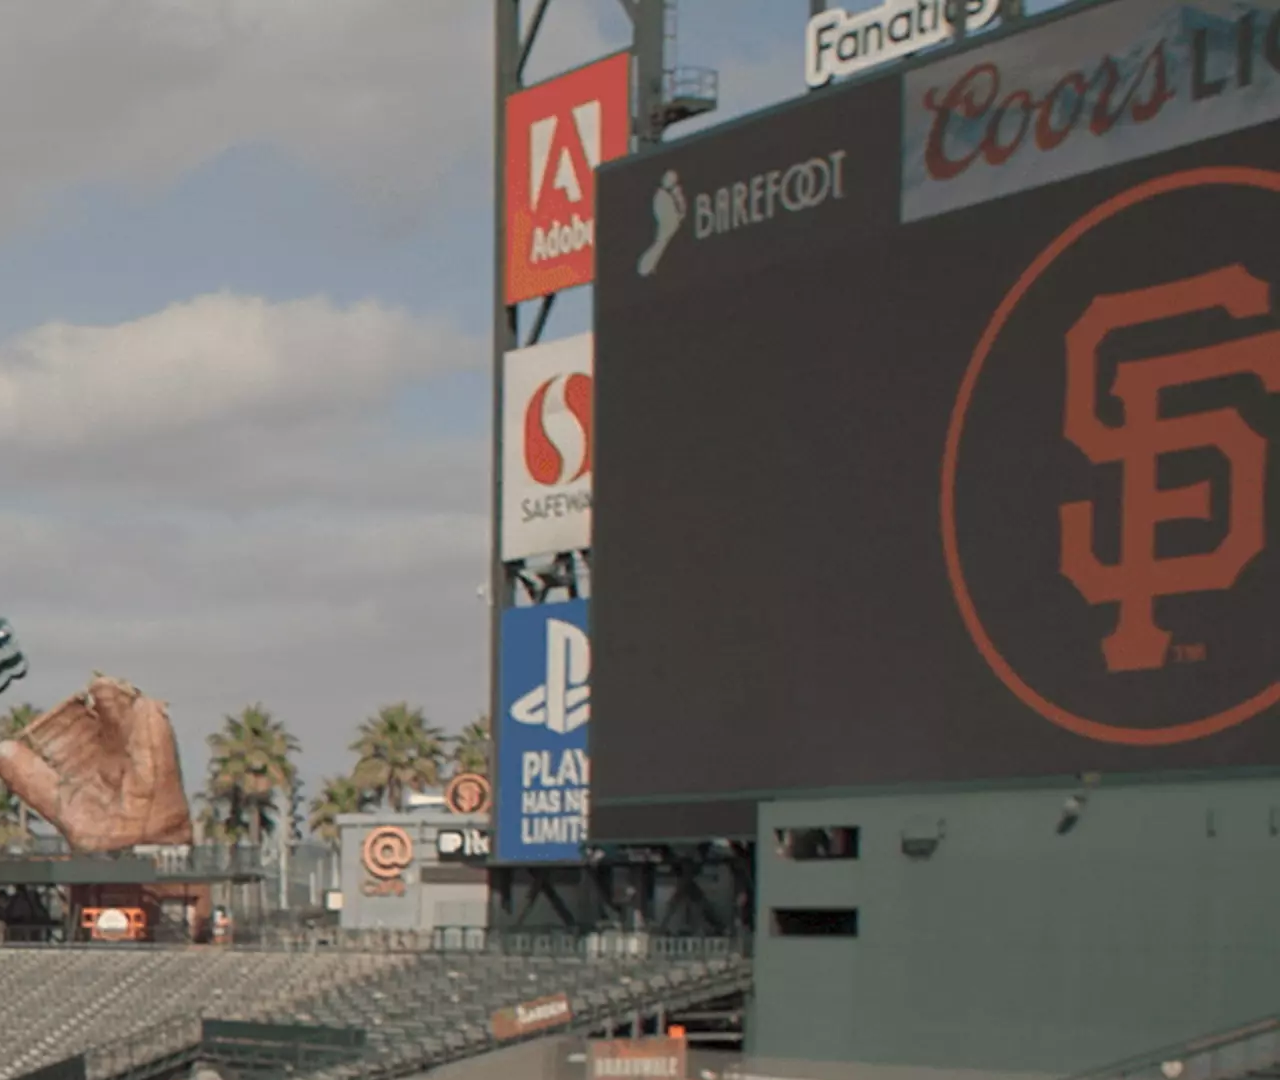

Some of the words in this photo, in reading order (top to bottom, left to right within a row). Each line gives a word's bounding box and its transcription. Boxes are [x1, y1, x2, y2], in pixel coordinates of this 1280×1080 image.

[922, 37, 1176, 182] Coors
[695, 150, 846, 240] BAREFOOT
[521, 492, 594, 524] SAFEWA
